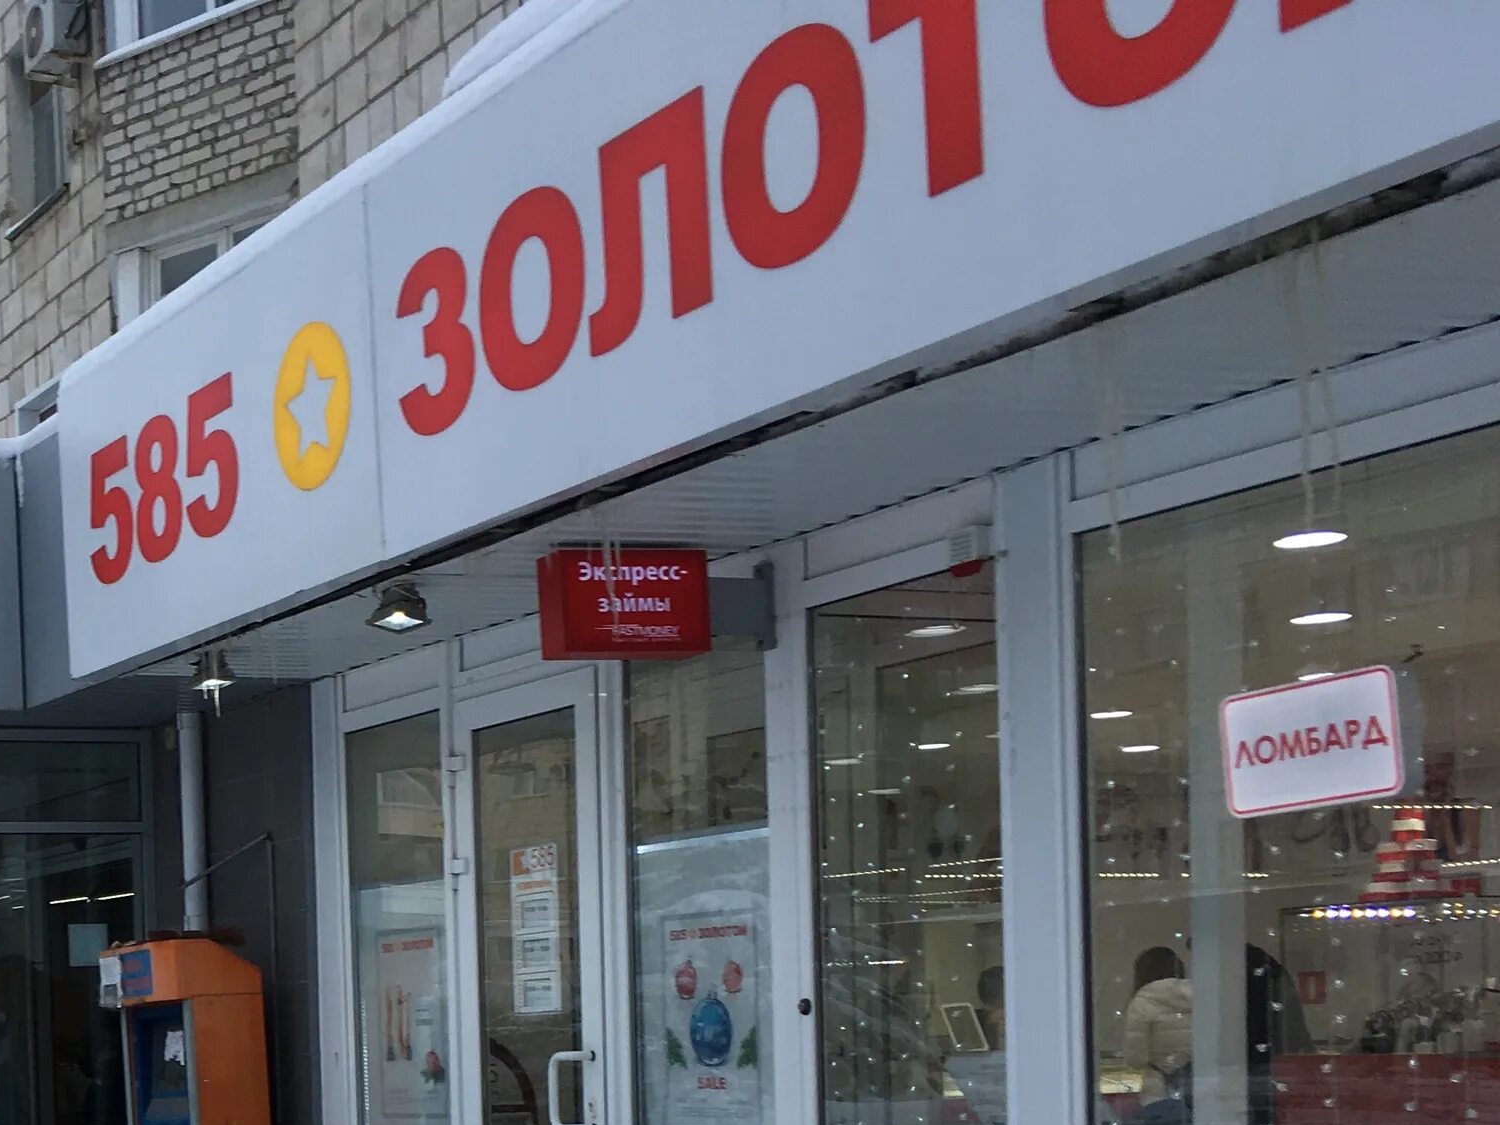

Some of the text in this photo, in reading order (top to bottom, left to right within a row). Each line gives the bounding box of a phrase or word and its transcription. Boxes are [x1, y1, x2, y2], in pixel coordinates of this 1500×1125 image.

[90, 0, 1354, 584] 585 ЗОЛОТ
[1234, 715, 1390, 769] ЛОМБАРД
[697, 1076, 727, 1090] SALE
